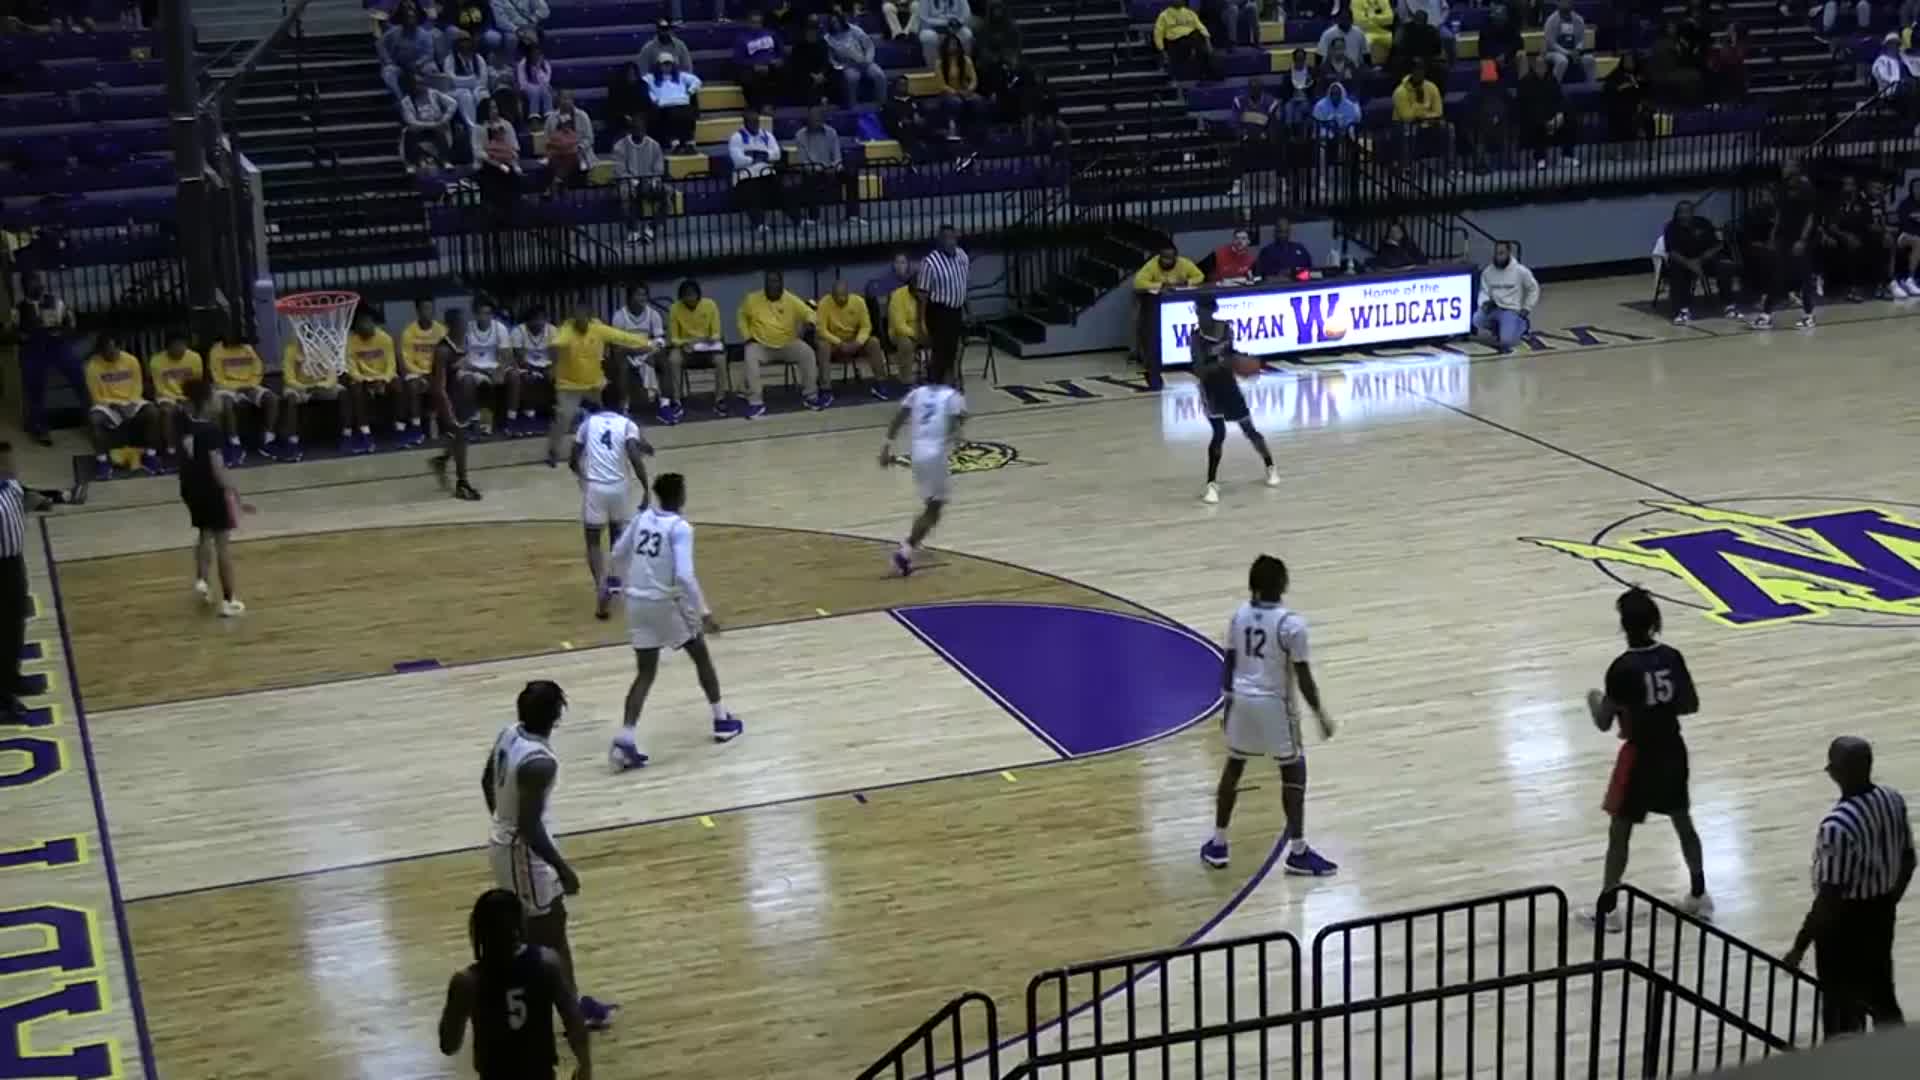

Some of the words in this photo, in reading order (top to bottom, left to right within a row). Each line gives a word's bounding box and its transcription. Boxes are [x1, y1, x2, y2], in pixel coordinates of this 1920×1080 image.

[1363, 287, 1400, 298] Home
[1403, 283, 1416, 295] of
[1420, 283, 1440, 294] the
[1350, 296, 1462, 330] WILDCATS
[601, 429, 612, 450] 4
[636, 529, 662, 558] 23
[1244, 625, 1267, 660] 12
[1644, 669, 1674, 706] 15
[505, 988, 527, 1030] 5
